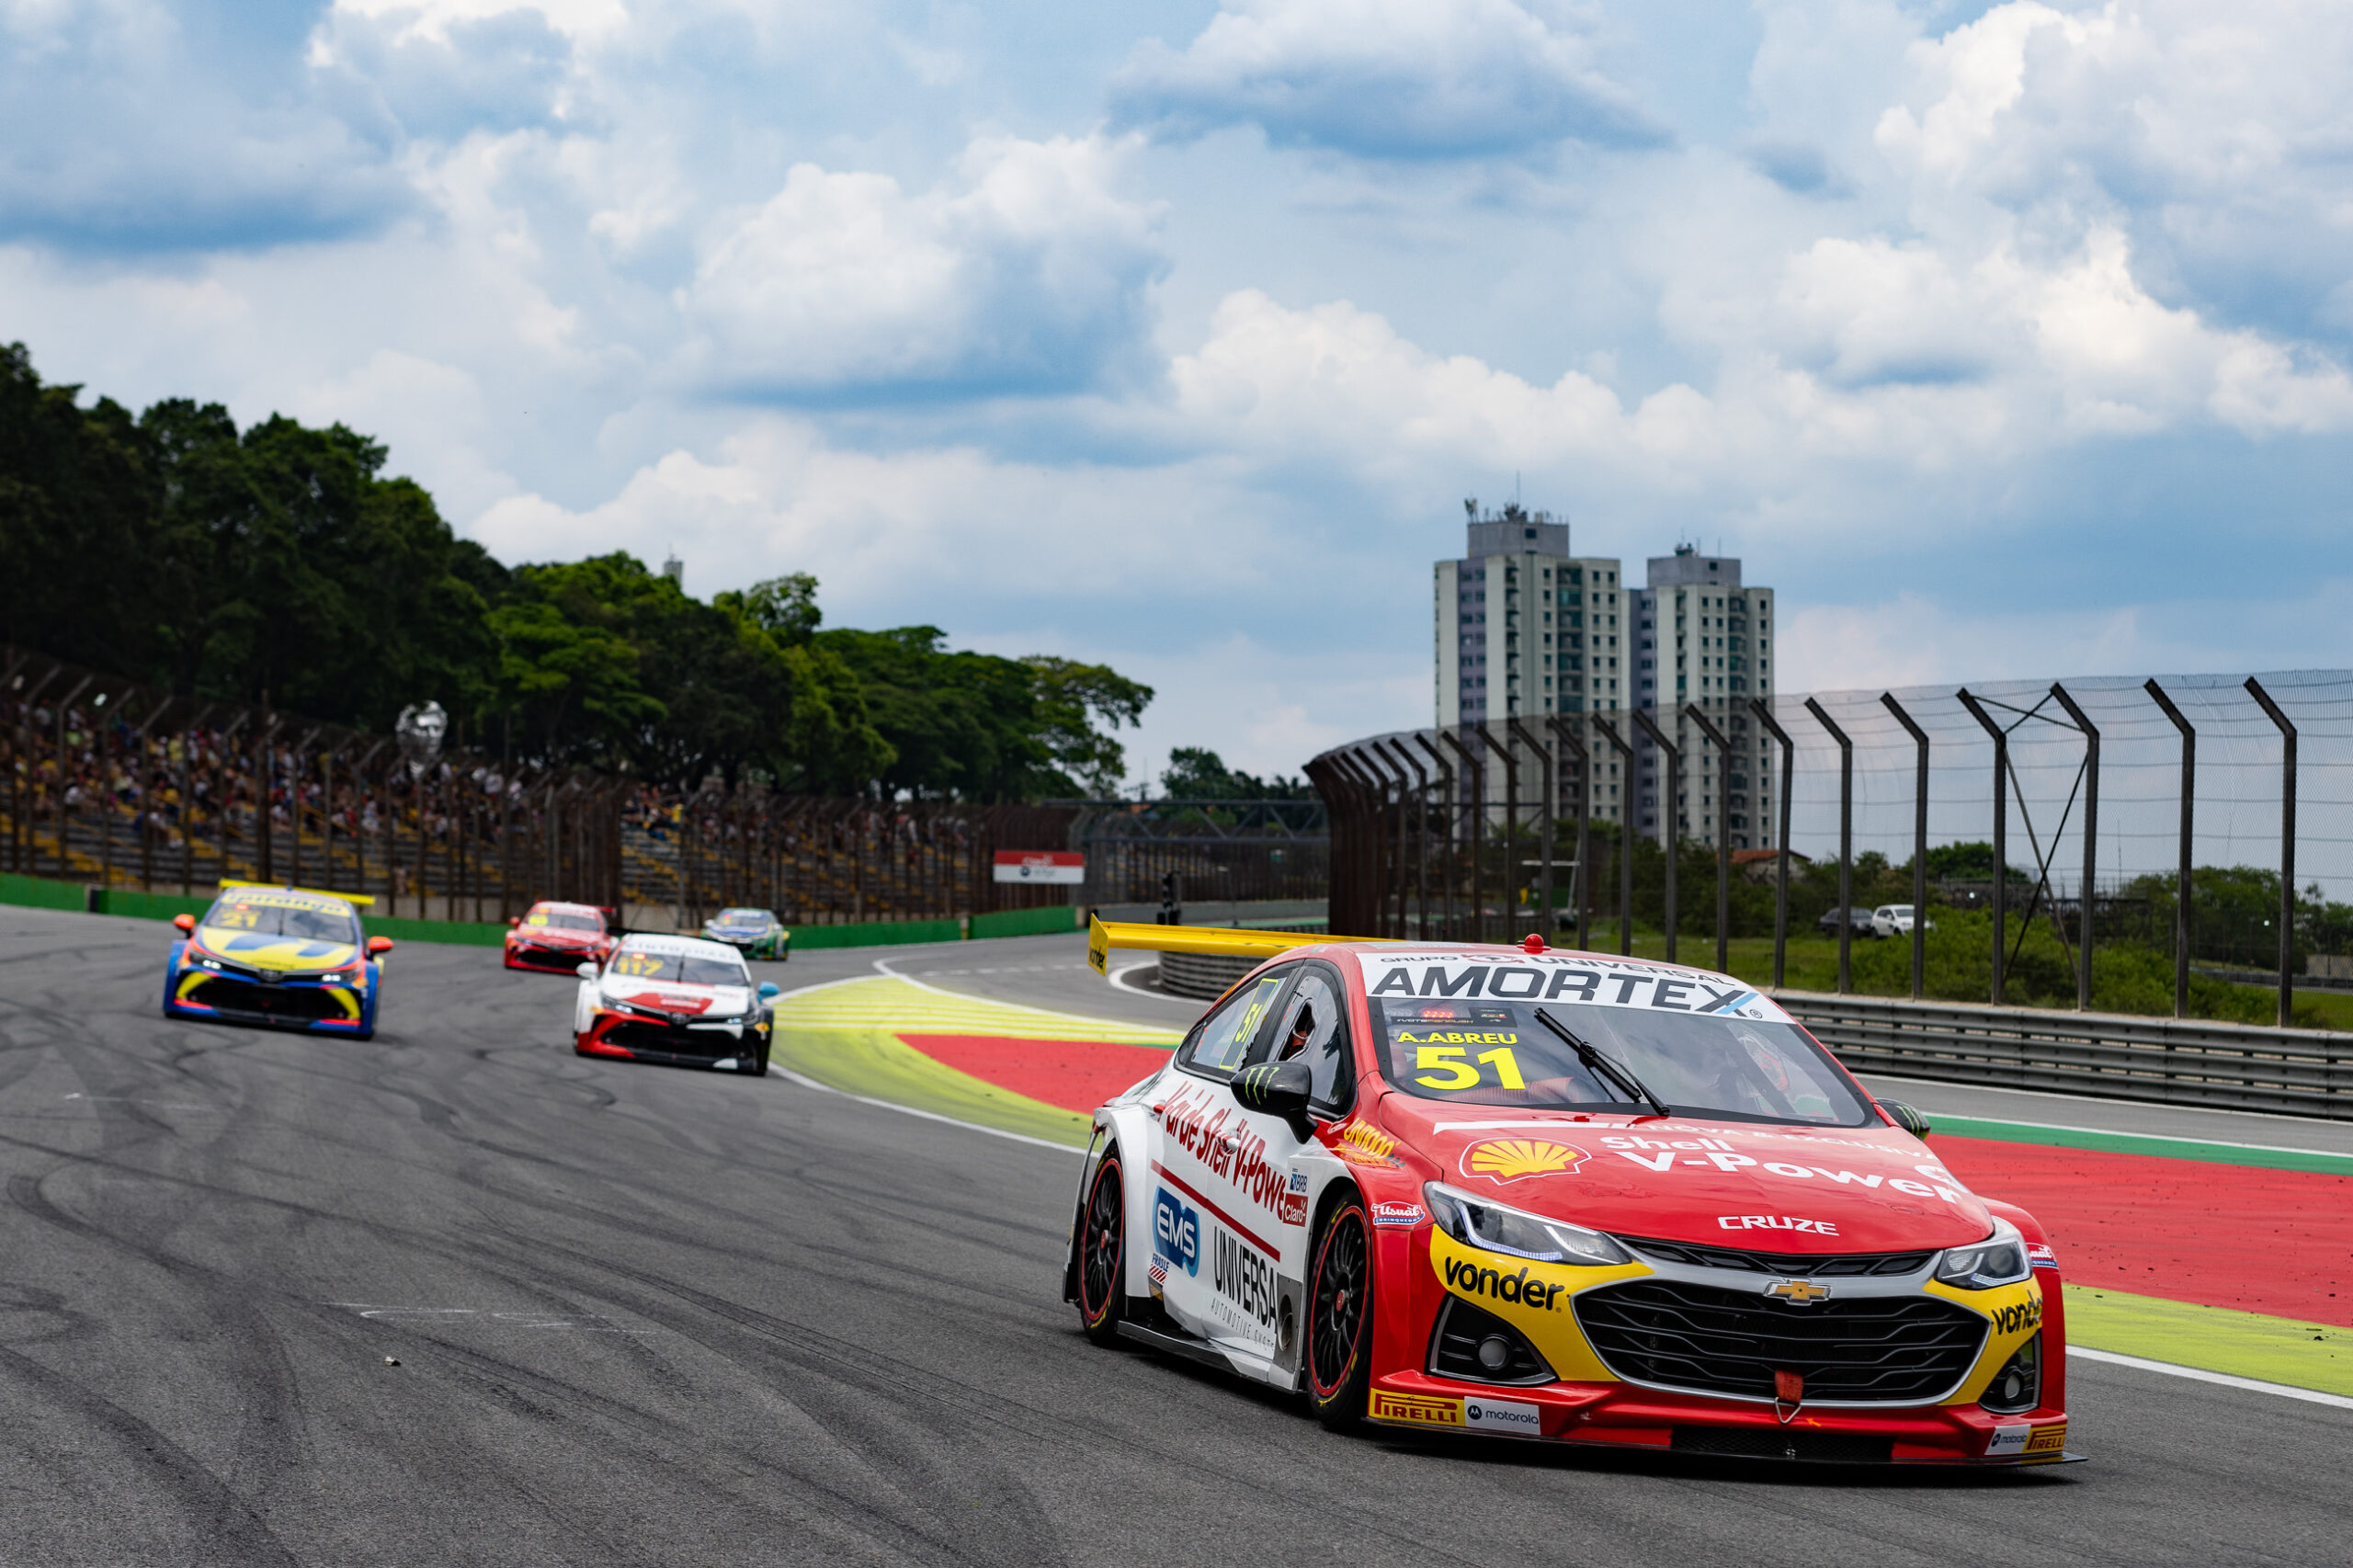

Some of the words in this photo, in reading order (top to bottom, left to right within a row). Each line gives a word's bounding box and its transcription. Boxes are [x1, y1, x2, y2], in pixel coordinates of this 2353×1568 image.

[1381, 955, 1458, 963] GRUPO
[1530, 956, 1735, 986] UNIVERSAL
[1370, 965, 1759, 1017] AMORTEX
[1397, 1031, 1518, 1045] A.ABREU
[1414, 1046, 1526, 1090] 51
[1600, 1135, 1736, 1152] Shell
[1233, 1129, 1287, 1221] V-Powe
[1613, 1151, 1962, 1204] V-Power
[1156, 1202, 1195, 1258] EMS
[1285, 1203, 1303, 1222] Claro
[1717, 1215, 1840, 1236] CRUZE
[1214, 1226, 1279, 1334] UNIVERSA
[1444, 1256, 1565, 1311] vonder
[1374, 1392, 1458, 1423] PIRELLI
[1485, 1409, 1539, 1425] motorola
[2026, 1427, 2065, 1450] PIRELL
